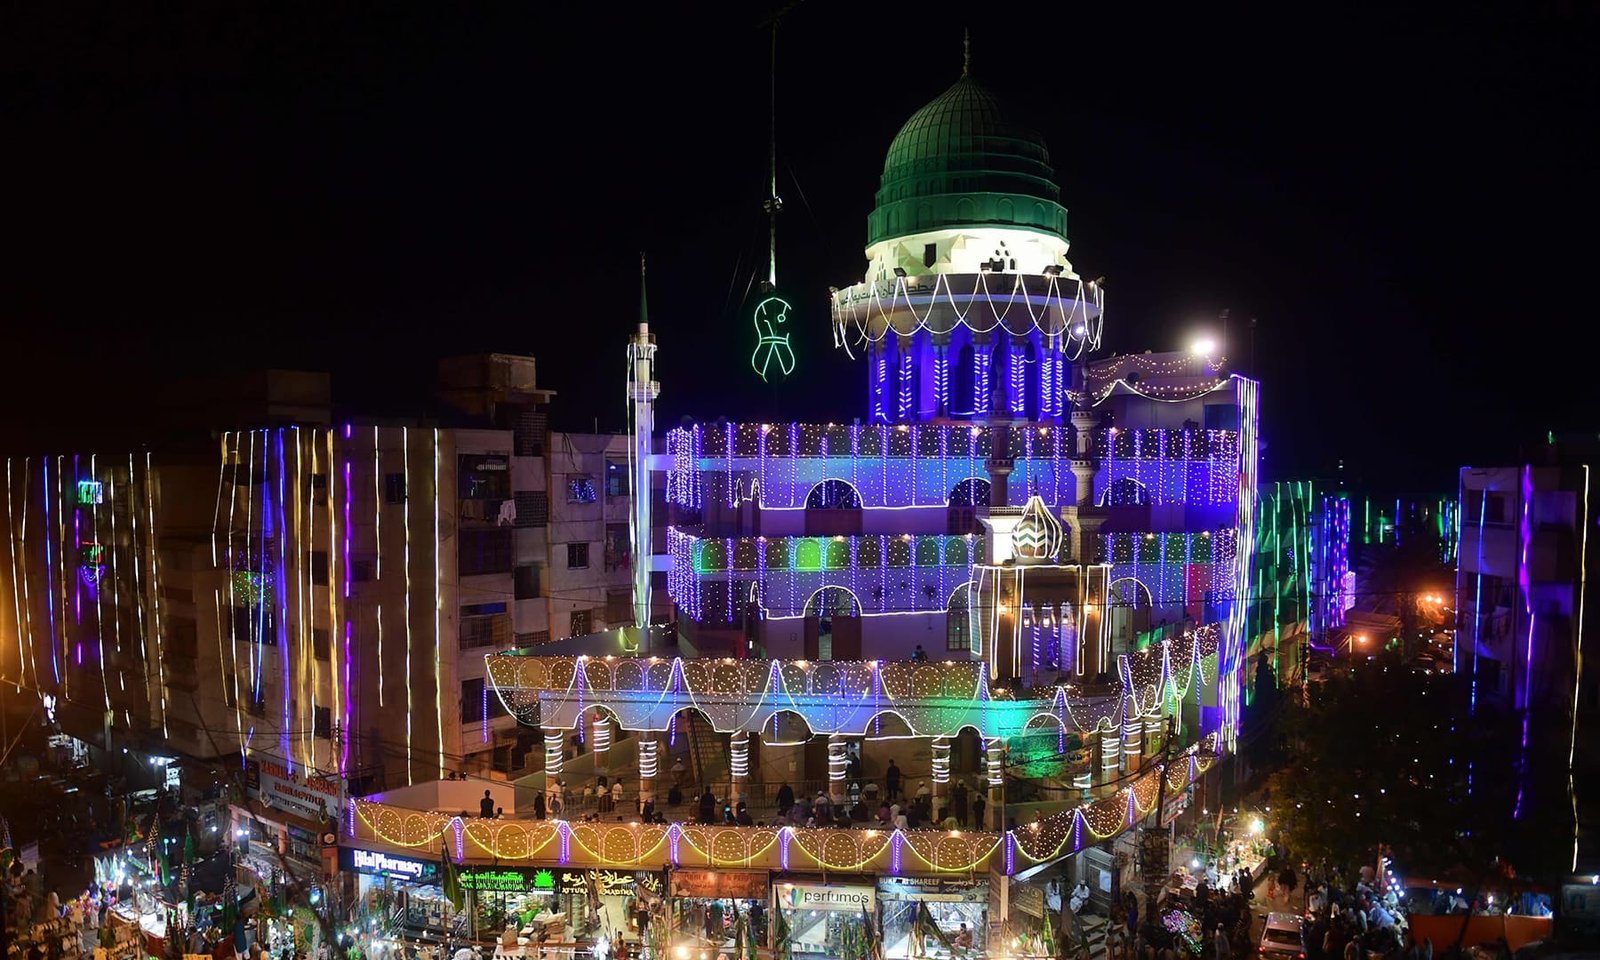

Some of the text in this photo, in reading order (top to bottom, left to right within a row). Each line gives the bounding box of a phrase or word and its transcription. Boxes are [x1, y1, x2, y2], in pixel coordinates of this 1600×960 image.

[375, 852, 423, 878] Pharmacy
[910, 878, 940, 886] SHAREEF
[804, 890, 869, 904] perfumo's
